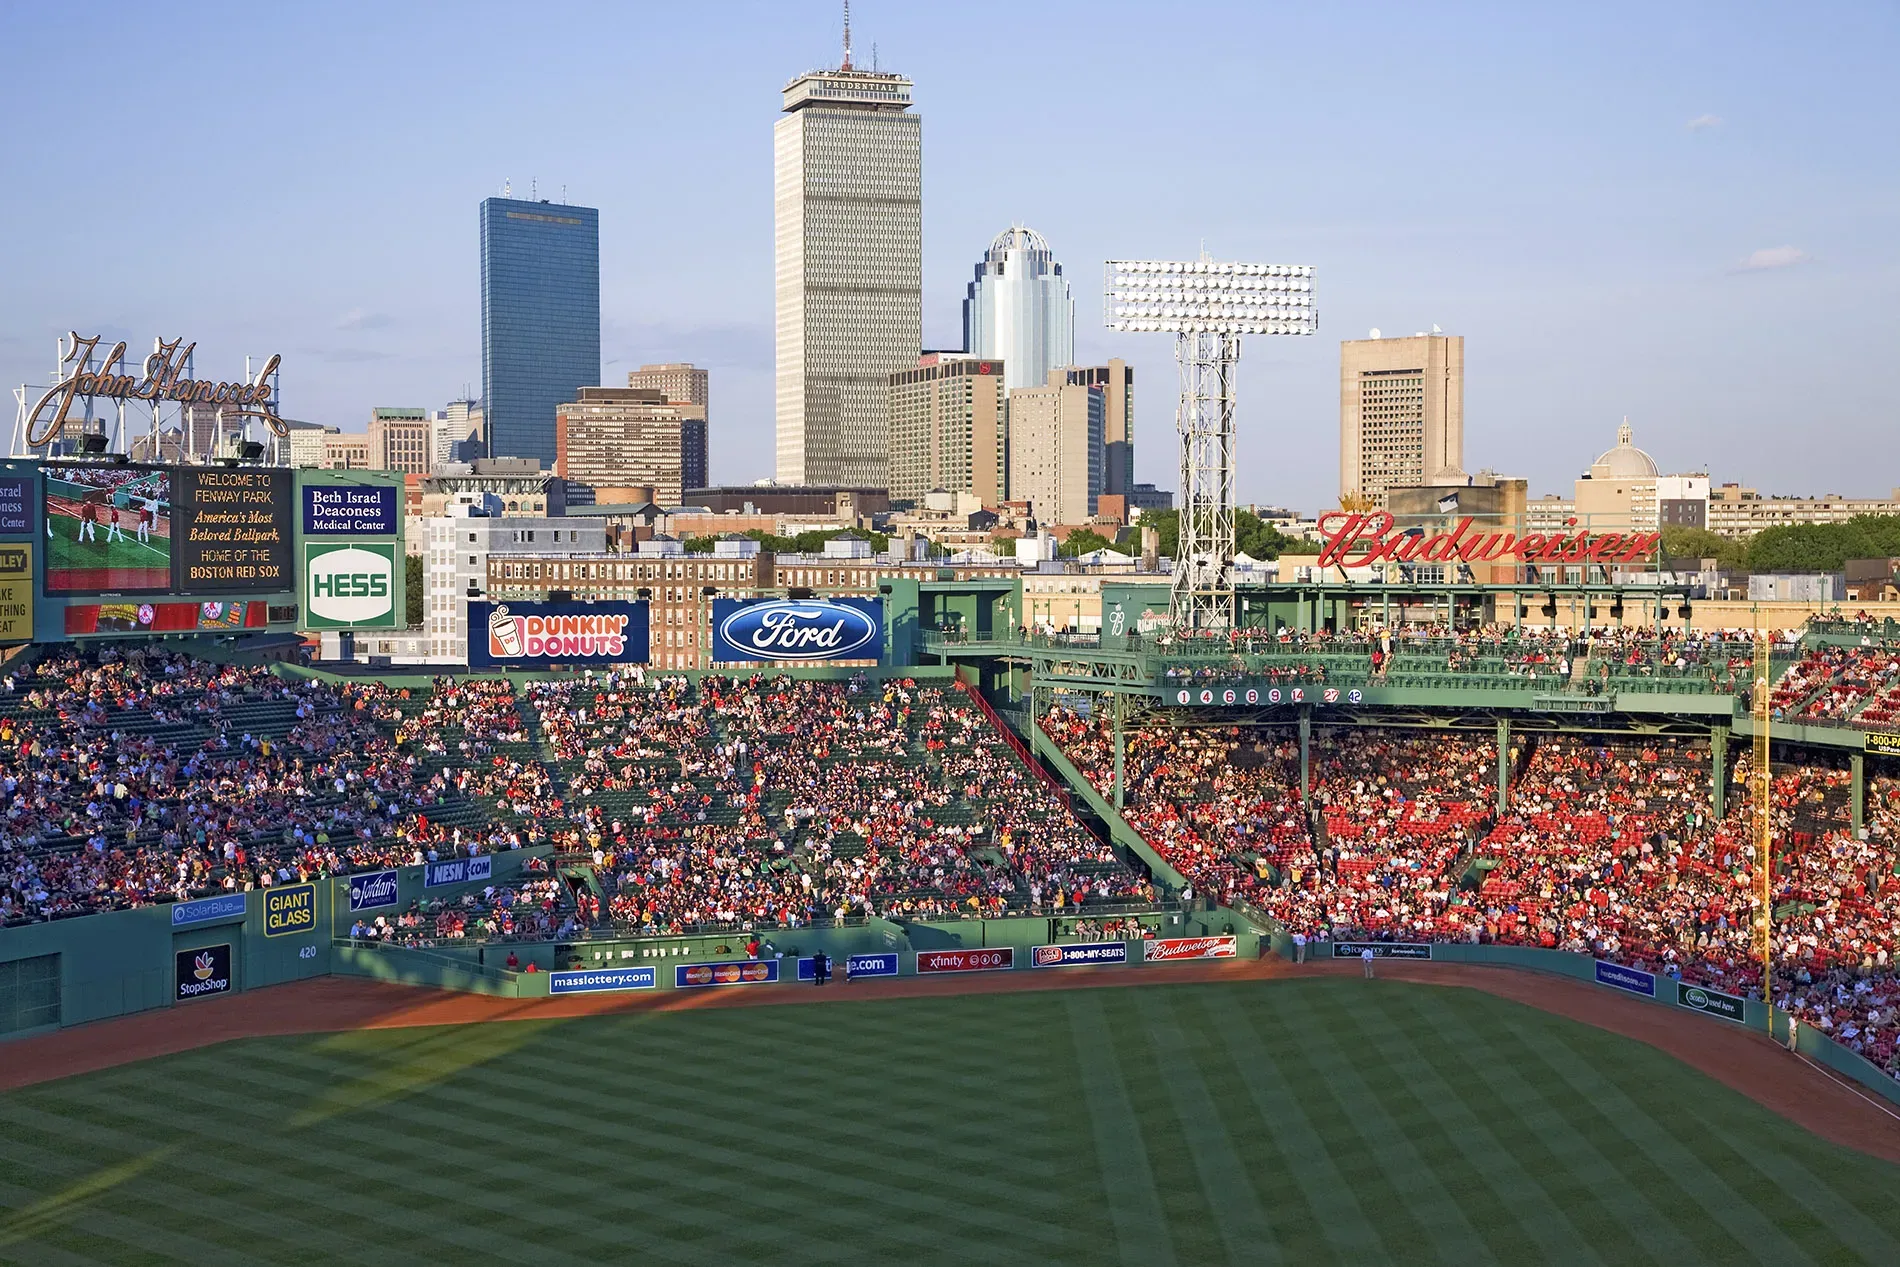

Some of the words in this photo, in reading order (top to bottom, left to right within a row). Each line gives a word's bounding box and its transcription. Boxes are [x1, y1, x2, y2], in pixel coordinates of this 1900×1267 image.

[826, 81, 894, 91] PRUDENTIAL
[26, 331, 137, 447] John
[134, 337, 288, 437] Hancock
[198, 473, 253, 487] WELCOME
[256, 475, 271, 487] TO
[195, 490, 241, 503] FENWAY
[243, 491, 274, 505] PARK,
[313, 491, 342, 503] Beth
[347, 491, 381, 504] Israel
[194, 510, 247, 524] America's
[248, 510, 274, 524] Most
[313, 504, 381, 517] Deaconess
[2, 516, 25, 528] Center
[313, 519, 351, 530] Medical
[354, 520, 385, 530] Center
[189, 528, 231, 541] Beloved
[233, 528, 280, 544] Ballpark,
[1317, 511, 1662, 568] Budweiser
[0, 554, 24, 568] LEY
[201, 550, 231, 562] HOME
[234, 550, 248, 562] OF
[250, 549, 270, 561] THE
[190, 567, 234, 579] BOSTON
[236, 566, 256, 578] RED
[258, 565, 280, 577] SOX
[314, 574, 387, 597] HESS
[0, 588, 12, 600] KE
[527, 616, 627, 636] DUNKIN'
[752, 608, 845, 648] Ford
[504, 636, 515, 645] DD
[527, 636, 622, 655] DONUTS
[1202, 691, 1210, 702] 4
[1225, 691, 1234, 702] 6
[1248, 691, 1256, 702] 8
[1271, 690, 1279, 701] 9
[1292, 690, 1304, 701] 14
[1324, 690, 1340, 701] 27
[1349, 690, 1361, 701] 42
[356, 873, 396, 910] Jordan's
[270, 892, 310, 911] GIANT
[269, 909, 311, 929] GLASS
[300, 946, 316, 959] 420
[1063, 948, 1124, 960] 1-800-MY-SEATS
[1152, 938, 1220, 960] Budweiser
[930, 955, 964, 969] xfinity
[554, 973, 651, 986] masslottery.com
[686, 971, 712, 979] MasterCard
[742, 968, 768, 976] MasterCard
[180, 978, 227, 995] Stop&Shop
[1708, 1000, 1721, 1008] used
